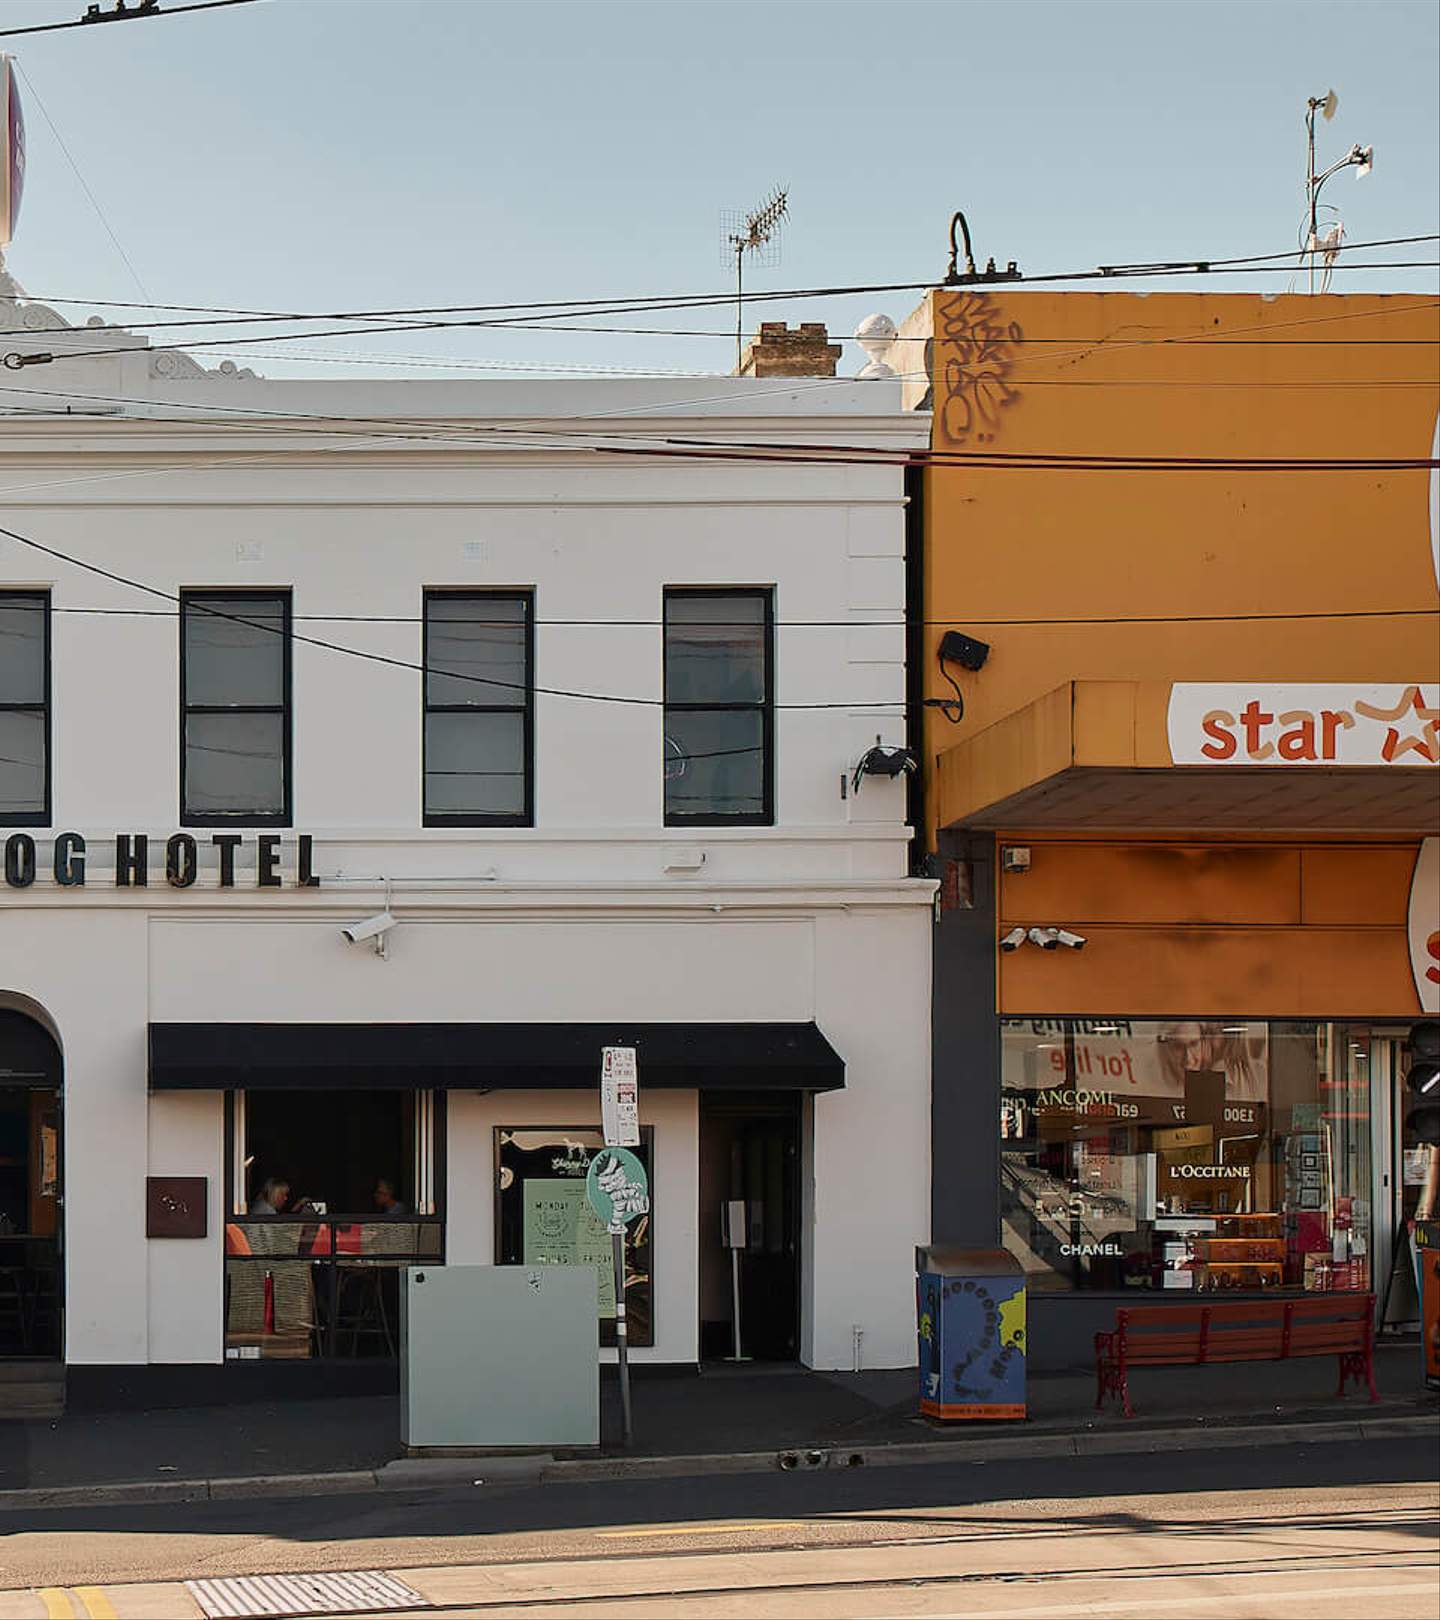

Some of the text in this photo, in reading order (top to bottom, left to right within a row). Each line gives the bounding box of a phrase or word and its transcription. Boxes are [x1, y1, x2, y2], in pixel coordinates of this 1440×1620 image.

[1201, 700, 1356, 761] star
[116, 833, 320, 888] HOTEL
[1170, 1164, 1251, 1178] L'OCCITANE
[1059, 1244, 1124, 1256] CHANEL
